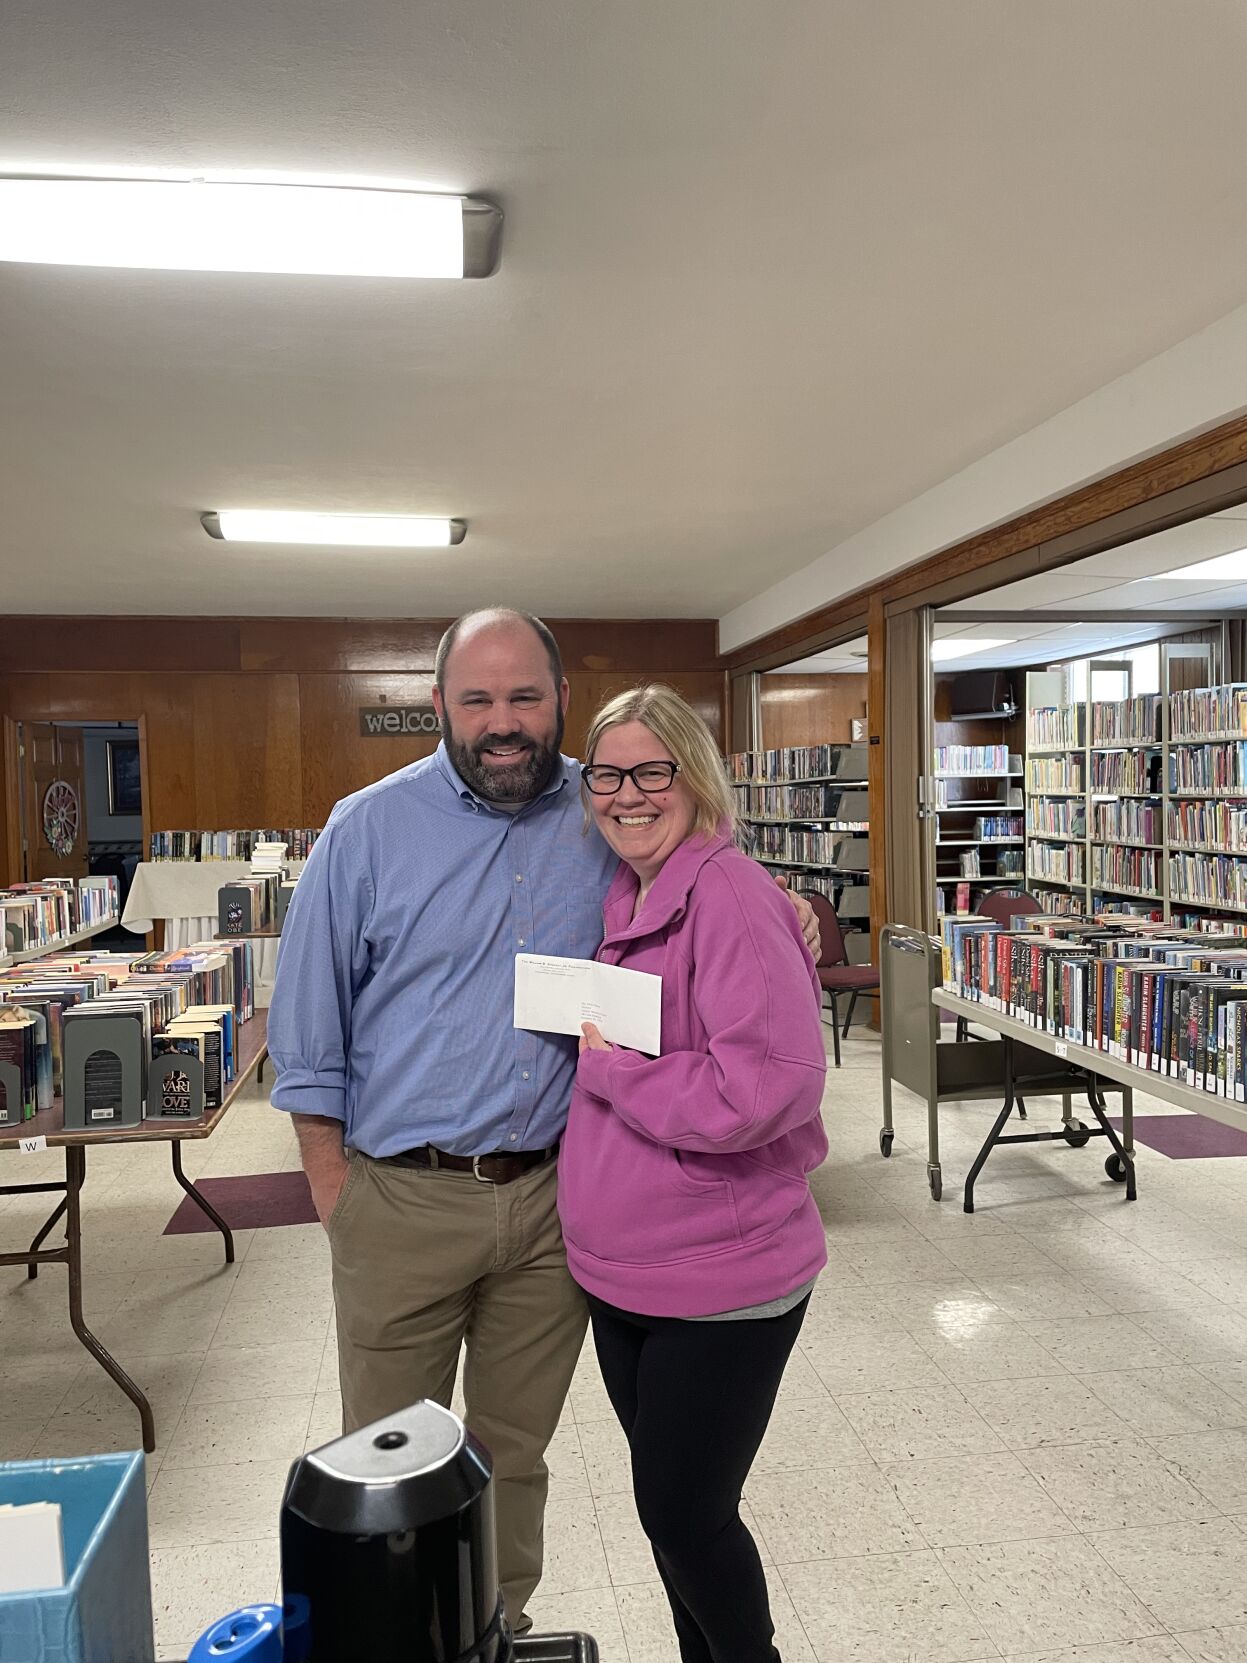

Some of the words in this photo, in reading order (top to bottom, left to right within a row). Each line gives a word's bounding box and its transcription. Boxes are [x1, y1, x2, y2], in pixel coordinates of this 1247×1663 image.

[365, 710, 441, 732] welco
[163, 1081, 190, 1092] WAR
[163, 1096, 190, 1108] OVE
[25, 1142, 36, 1151] W
